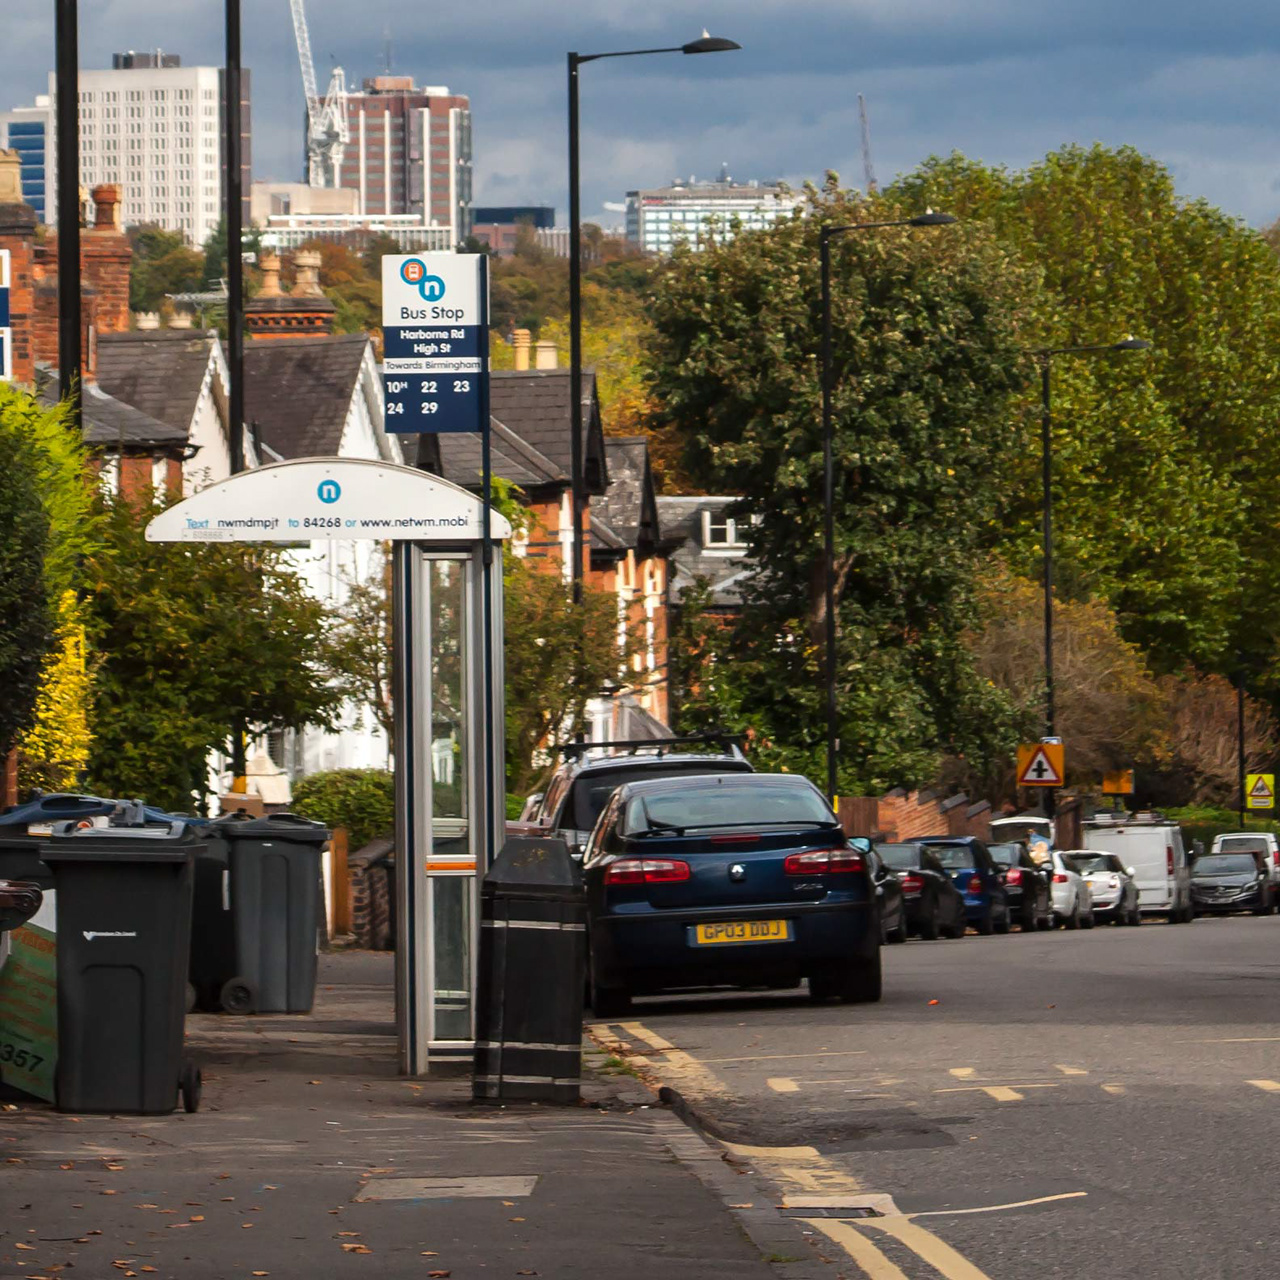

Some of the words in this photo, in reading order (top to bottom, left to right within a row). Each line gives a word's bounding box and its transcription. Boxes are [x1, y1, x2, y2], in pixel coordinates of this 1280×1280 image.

[400, 307, 427, 320] Bus
[431, 306, 465, 322] Stop
[400, 329, 449, 339] Harborne
[450, 328, 465, 339] Rd
[413, 343, 438, 355] High
[440, 342, 451, 353] St
[386, 361, 423, 370] Towards
[425, 360, 480, 371] Birmingham
[421, 381, 438, 393] 22
[453, 380, 470, 393] 23
[387, 402, 404, 415] 24
[421, 402, 439, 414] 29
[186, 518, 209, 529] Text
[217, 517, 279, 530] nwmdmpjt
[288, 518, 300, 528] to
[303, 517, 341, 528] 84268
[345, 519, 357, 528] or
[360, 515, 469, 527] www.netwm.mobi
